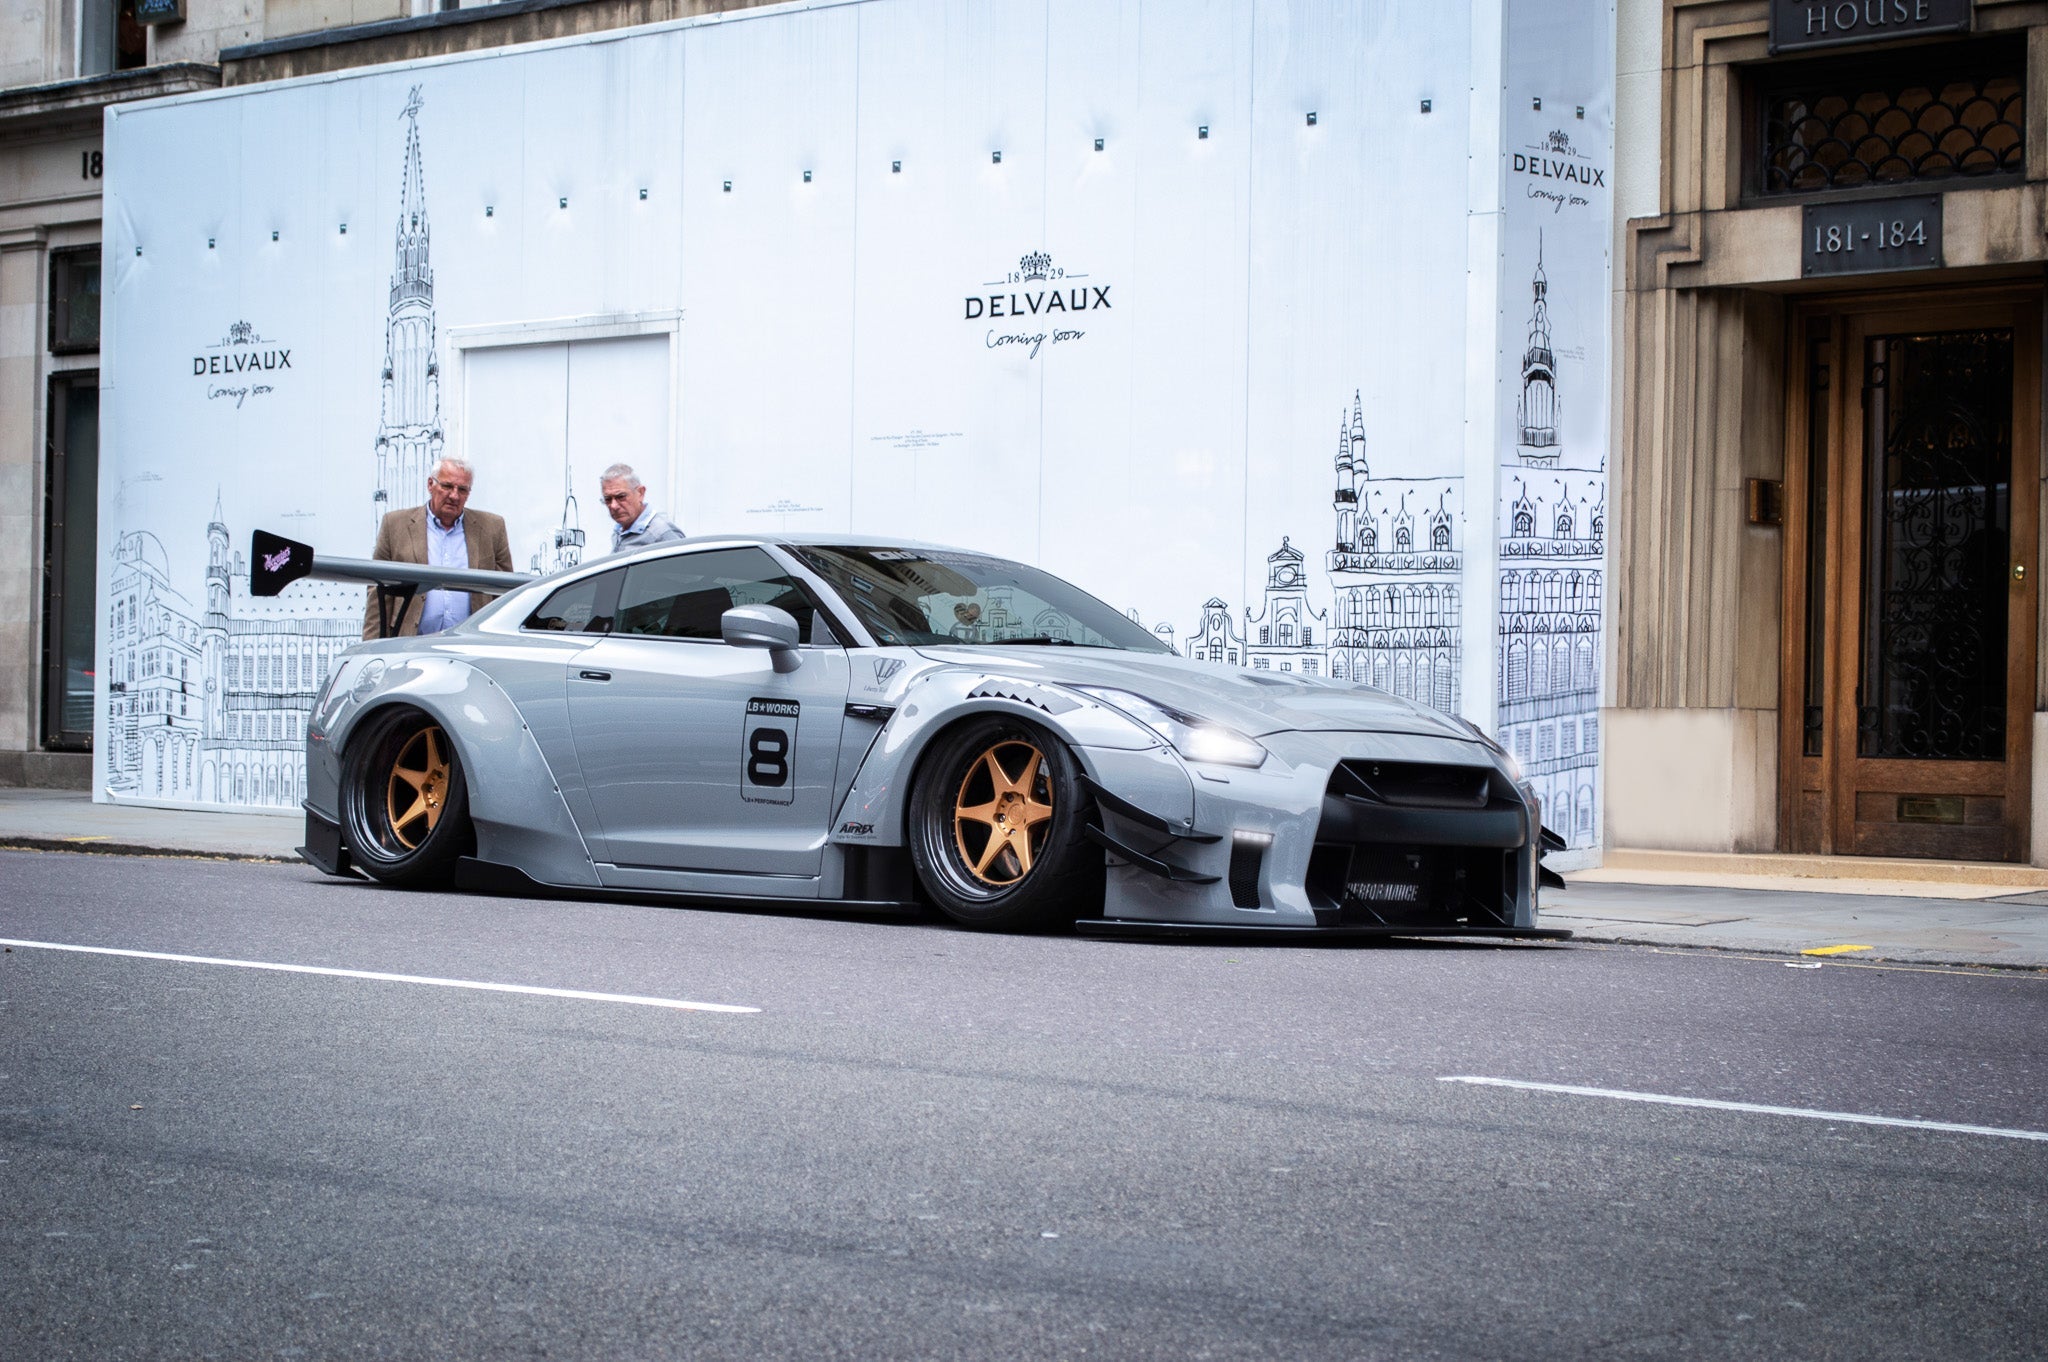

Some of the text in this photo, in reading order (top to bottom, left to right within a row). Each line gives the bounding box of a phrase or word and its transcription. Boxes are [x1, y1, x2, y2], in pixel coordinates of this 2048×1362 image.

[1806, 0, 1929, 34] HOUSE
[1513, 153, 1605, 188] DELVAUX
[1527, 183, 1567, 214] Coming
[1008, 267, 1064, 284] 18 29
[965, 286, 1111, 320] DELVAUX
[986, 329, 1047, 359] Coming
[193, 349, 292, 376] DELVAUX
[208, 383, 248, 409] Coming
[747, 727, 789, 787] 8
[1344, 883, 1419, 902] PERFORMANCE
